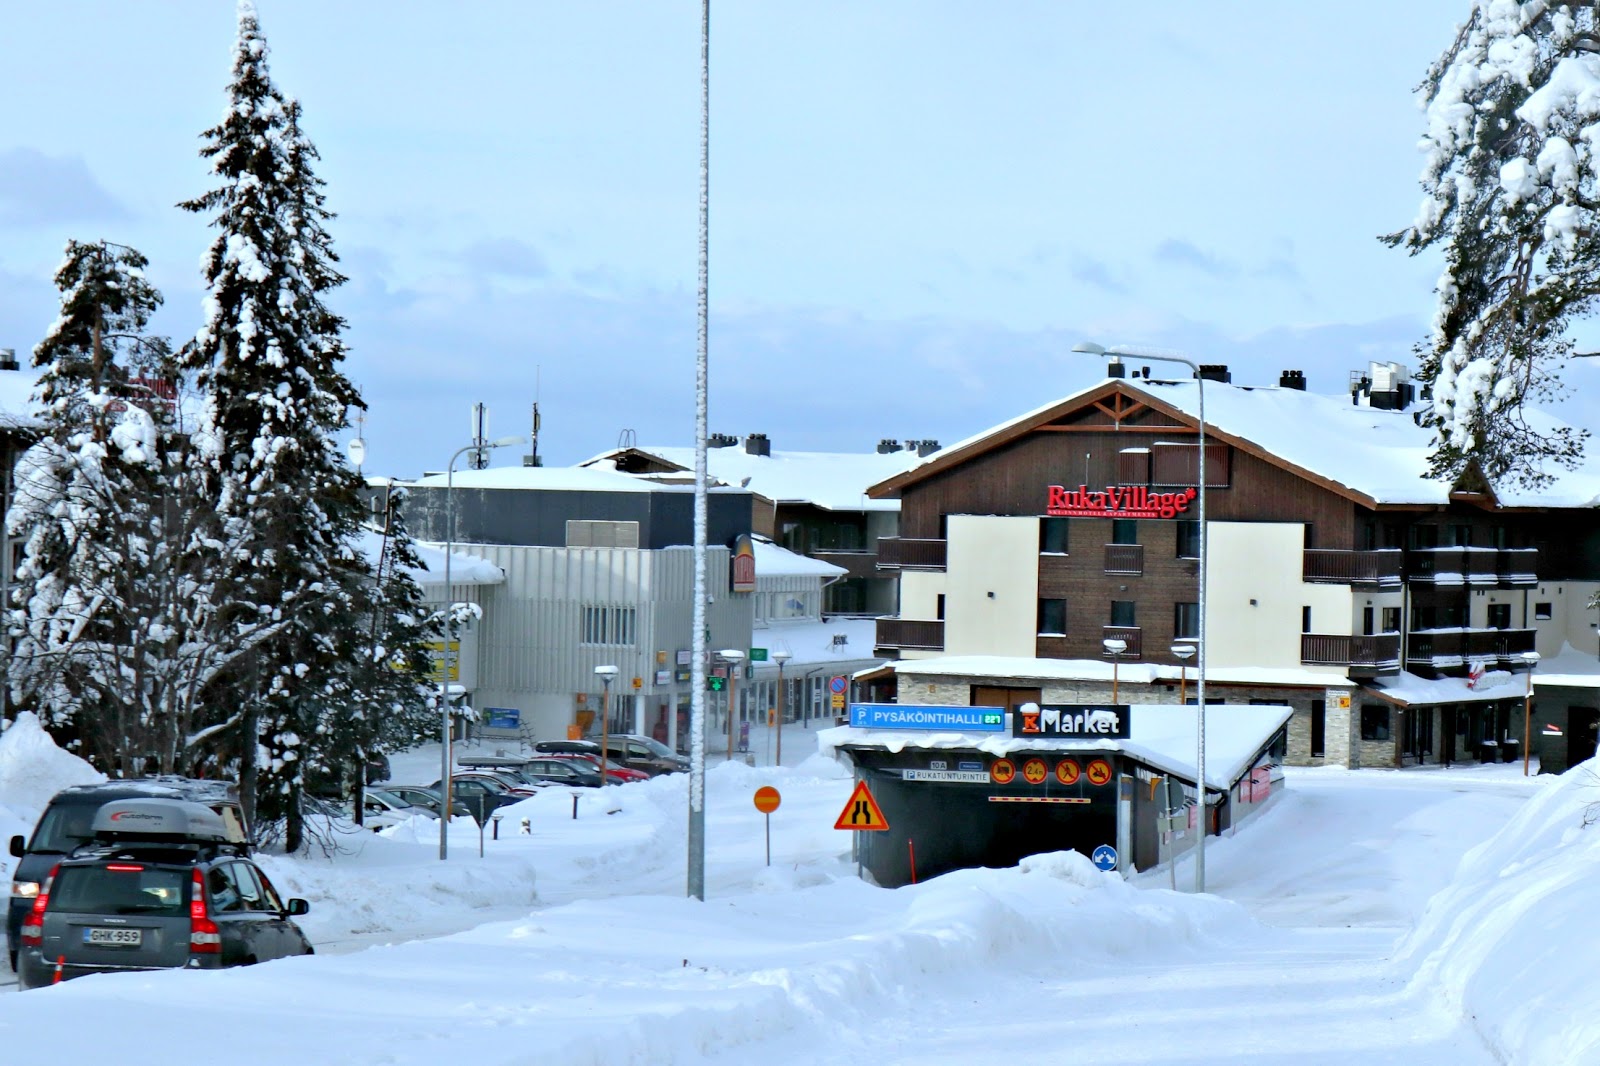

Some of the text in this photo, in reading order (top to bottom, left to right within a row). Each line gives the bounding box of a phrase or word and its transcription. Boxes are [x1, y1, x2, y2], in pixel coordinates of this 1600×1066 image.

[874, 711, 982, 724] PYSÄKÖINTIHALLI
[1041, 709, 1120, 733] Market
[917, 771, 987, 780] RUKATUNTURINTIE
[91, 930, 139, 942] GHK-959
